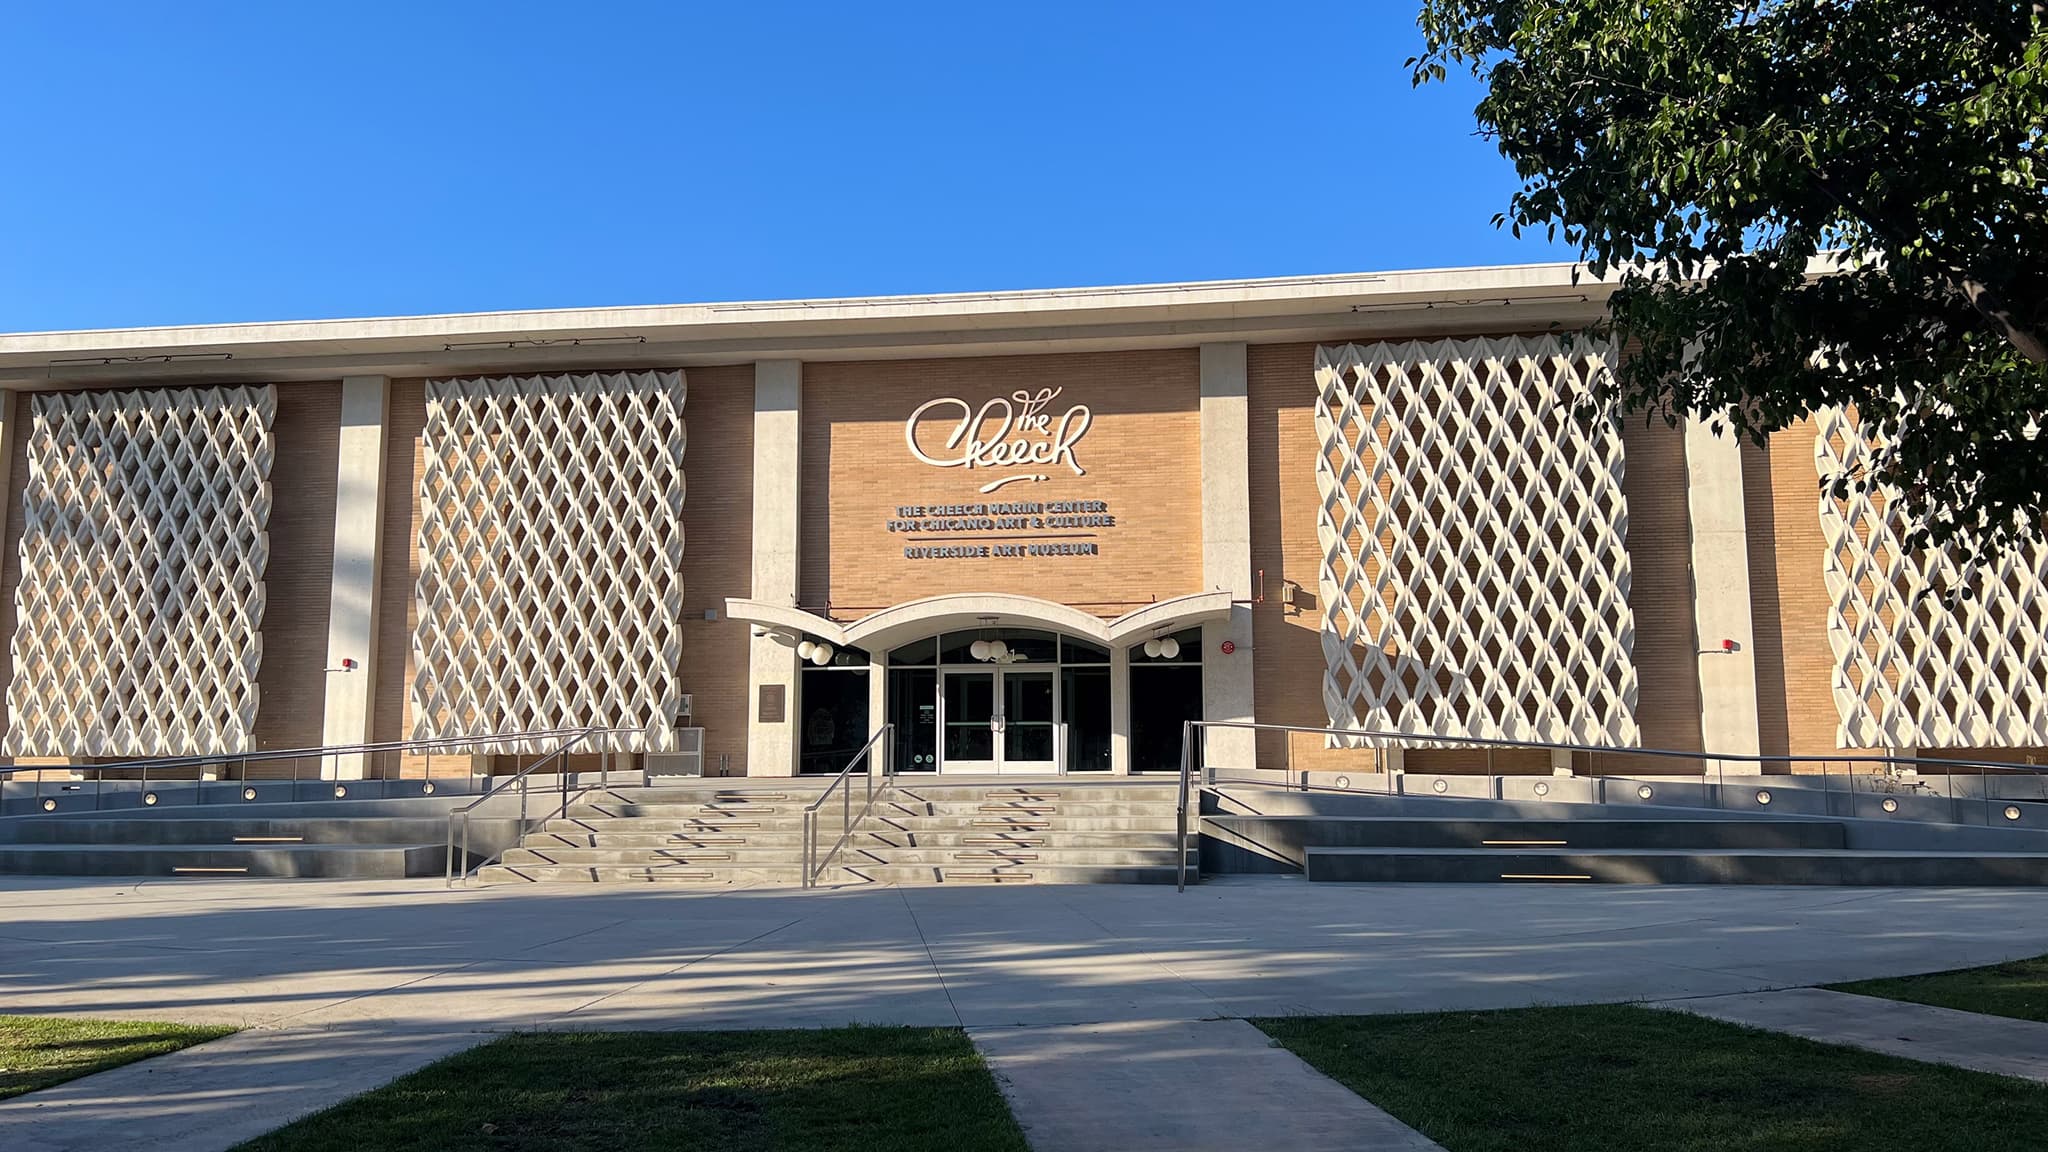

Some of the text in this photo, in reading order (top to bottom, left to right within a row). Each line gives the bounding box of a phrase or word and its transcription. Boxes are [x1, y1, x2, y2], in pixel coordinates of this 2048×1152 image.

[905, 397, 1089, 475] Cheech
[896, 500, 1104, 517] THE CHEECH MARIN CENTER
[887, 514, 1114, 531] FOR CHICANO ART & CULTURE
[904, 543, 1096, 557] RIVERSIDE ART MUSEUM
